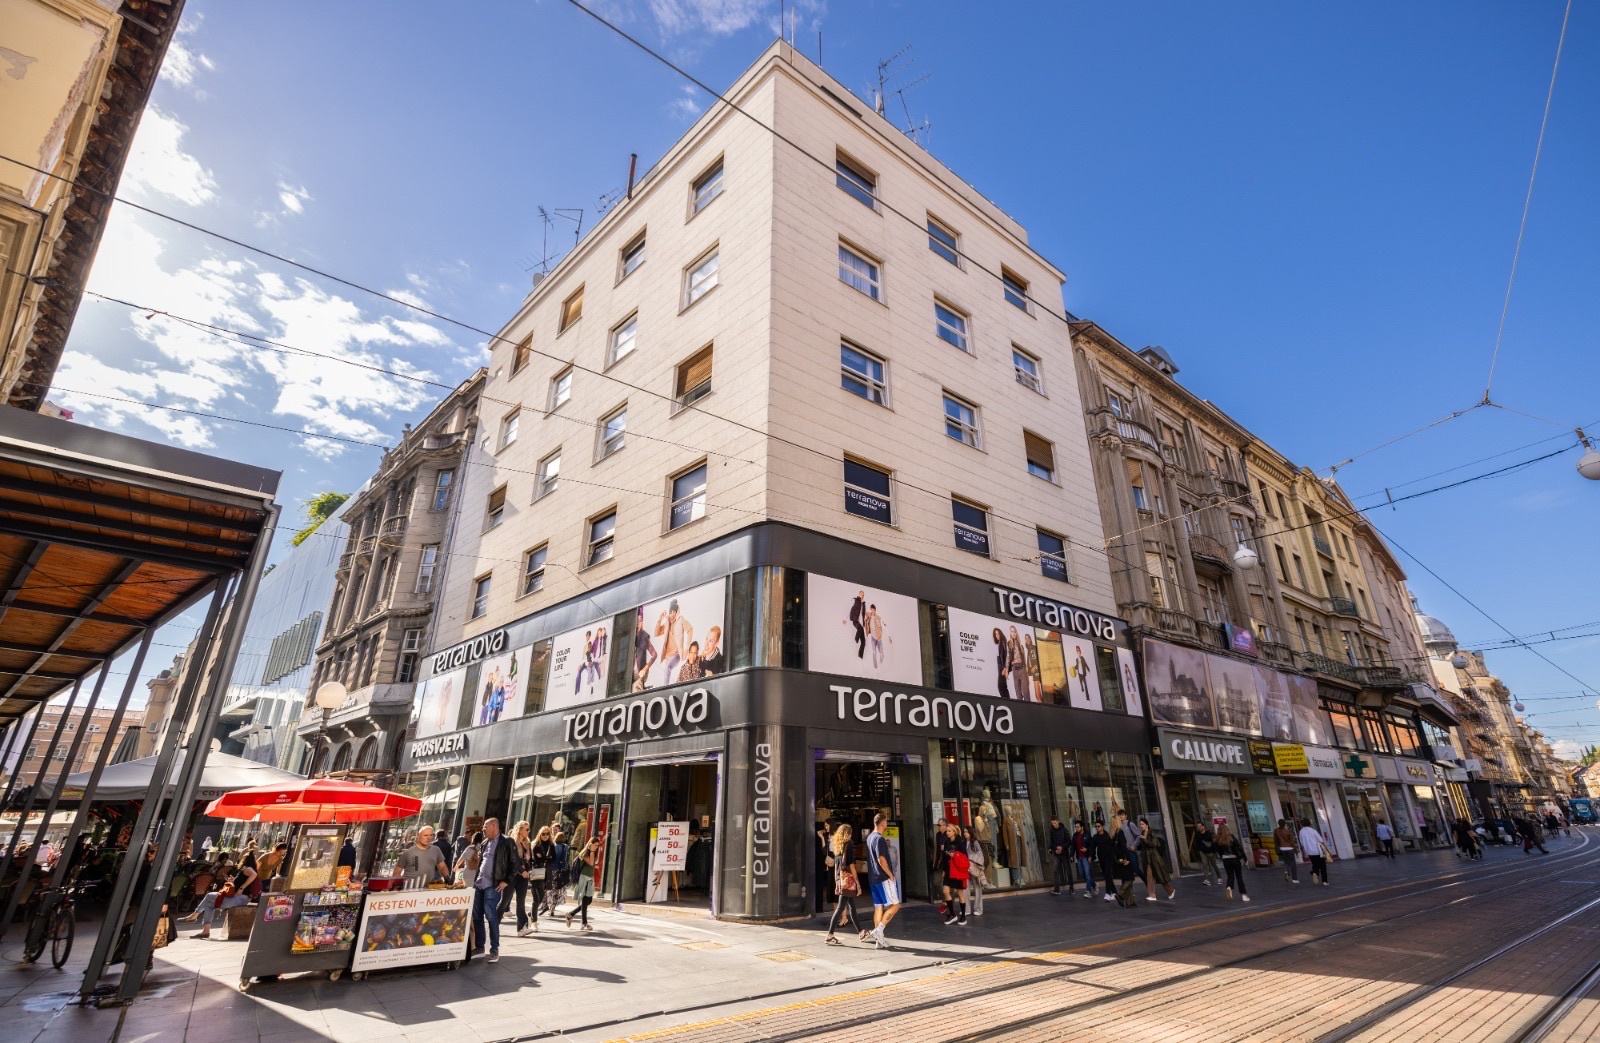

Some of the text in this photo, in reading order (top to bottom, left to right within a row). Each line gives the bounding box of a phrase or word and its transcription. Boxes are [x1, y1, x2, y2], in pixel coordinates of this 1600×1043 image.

[993, 587, 1116, 640] Terranova
[959, 631, 979, 641] COLOR
[960, 638, 977, 647] YOUR
[431, 629, 505, 674] Terranova
[563, 687, 708, 742] Terranova
[829, 684, 1014, 735] Terranova
[410, 733, 465, 758] PROSVJETA
[1171, 739, 1245, 765] CALLIOPE
[752, 743, 771, 894] Terranova
[668, 828, 680, 836] 50
[666, 854, 678, 862] 50
[369, 899, 417, 911] KESTENI
[426, 895, 471, 907] MARONI
